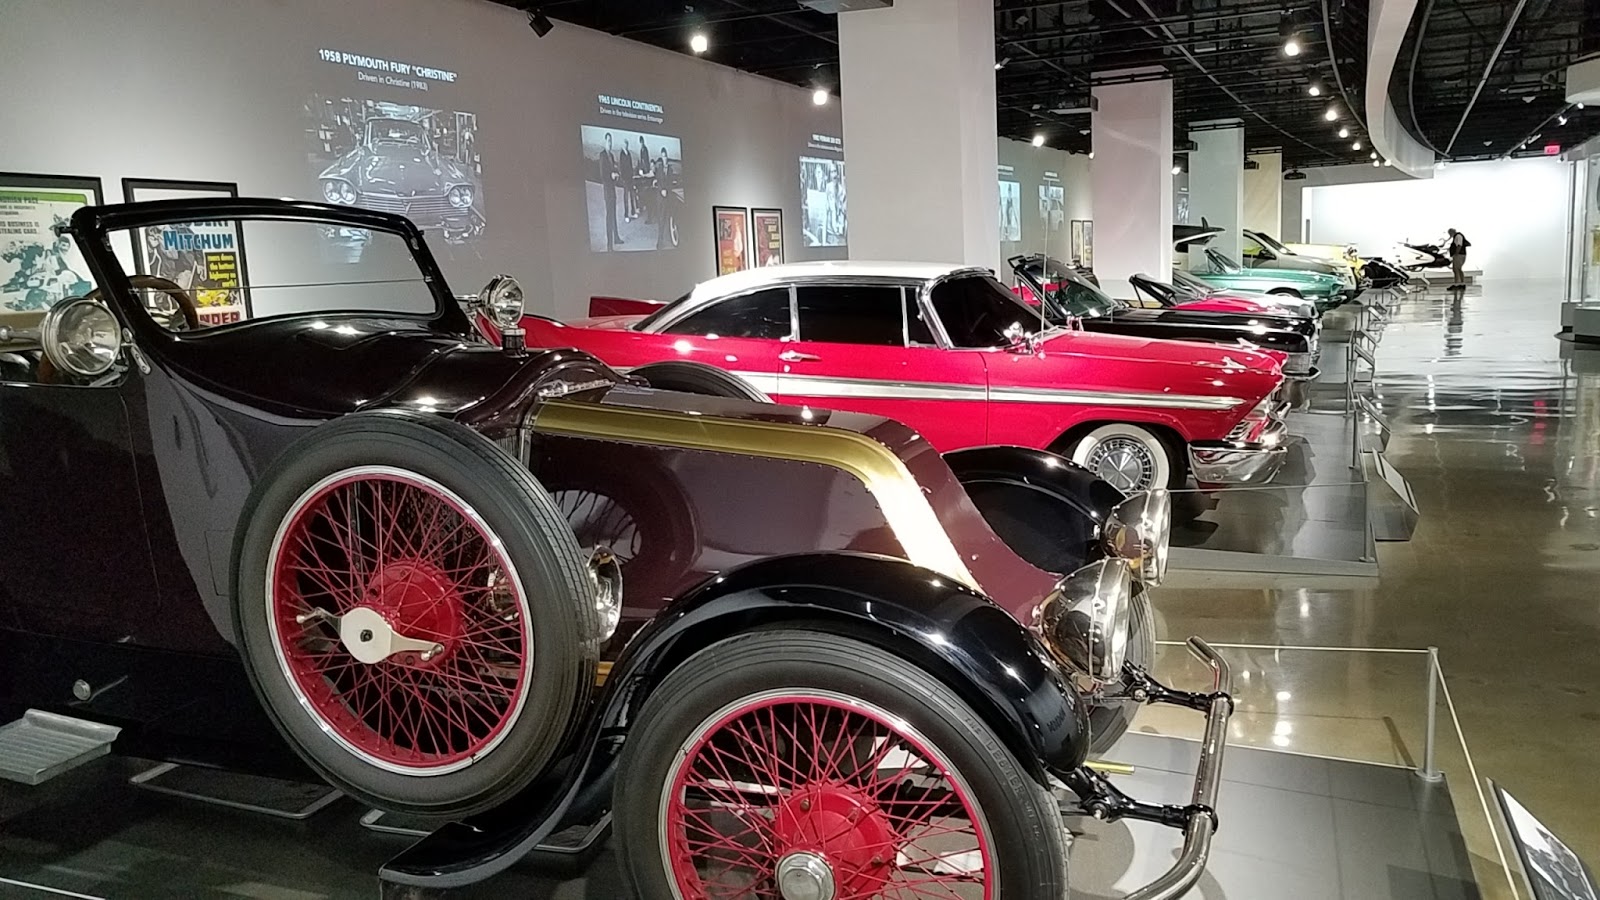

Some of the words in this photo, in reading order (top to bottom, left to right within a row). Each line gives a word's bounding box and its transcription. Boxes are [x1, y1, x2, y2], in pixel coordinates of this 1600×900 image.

[318, 48, 342, 63] 1958
[342, 53, 390, 72] PLYMOUTH
[390, 62, 412, 75] FURY
[412, 66, 458, 83] "CHRISTINE"
[357, 71, 378, 83] Driven
[379, 74, 385, 84] in
[385, 76, 410, 88] Christine
[611, 96, 632, 108] LINCOLN
[632, 101, 664, 113] CONTINENTAL
[163, 230, 234, 251] MITCHUM
[985, 741, 1025, 793] LESTER
